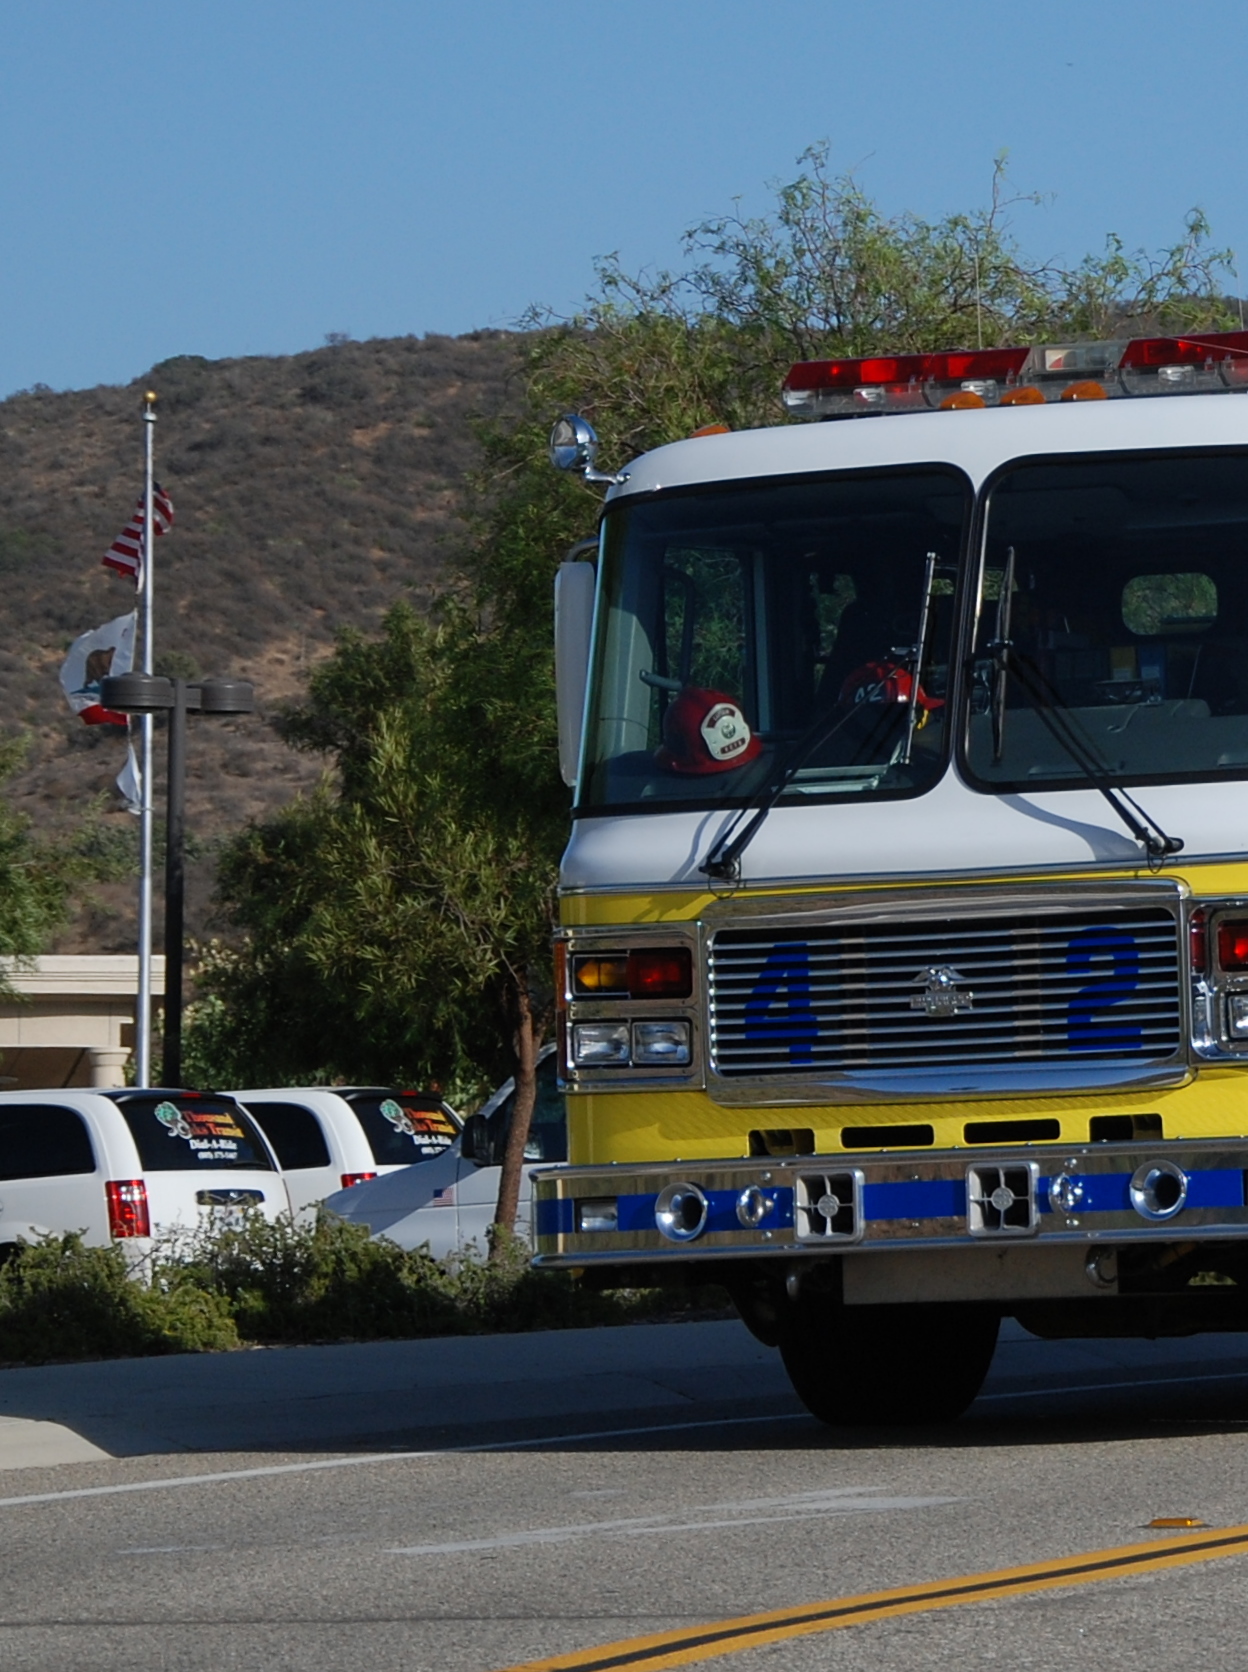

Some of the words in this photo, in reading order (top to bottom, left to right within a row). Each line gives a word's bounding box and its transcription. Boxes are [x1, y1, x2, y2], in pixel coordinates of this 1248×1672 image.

[745, 943, 819, 1064] 4
[1066, 926, 1142, 1051] 2
[189, 1139, 238, 1150] Dial-A-Ride
